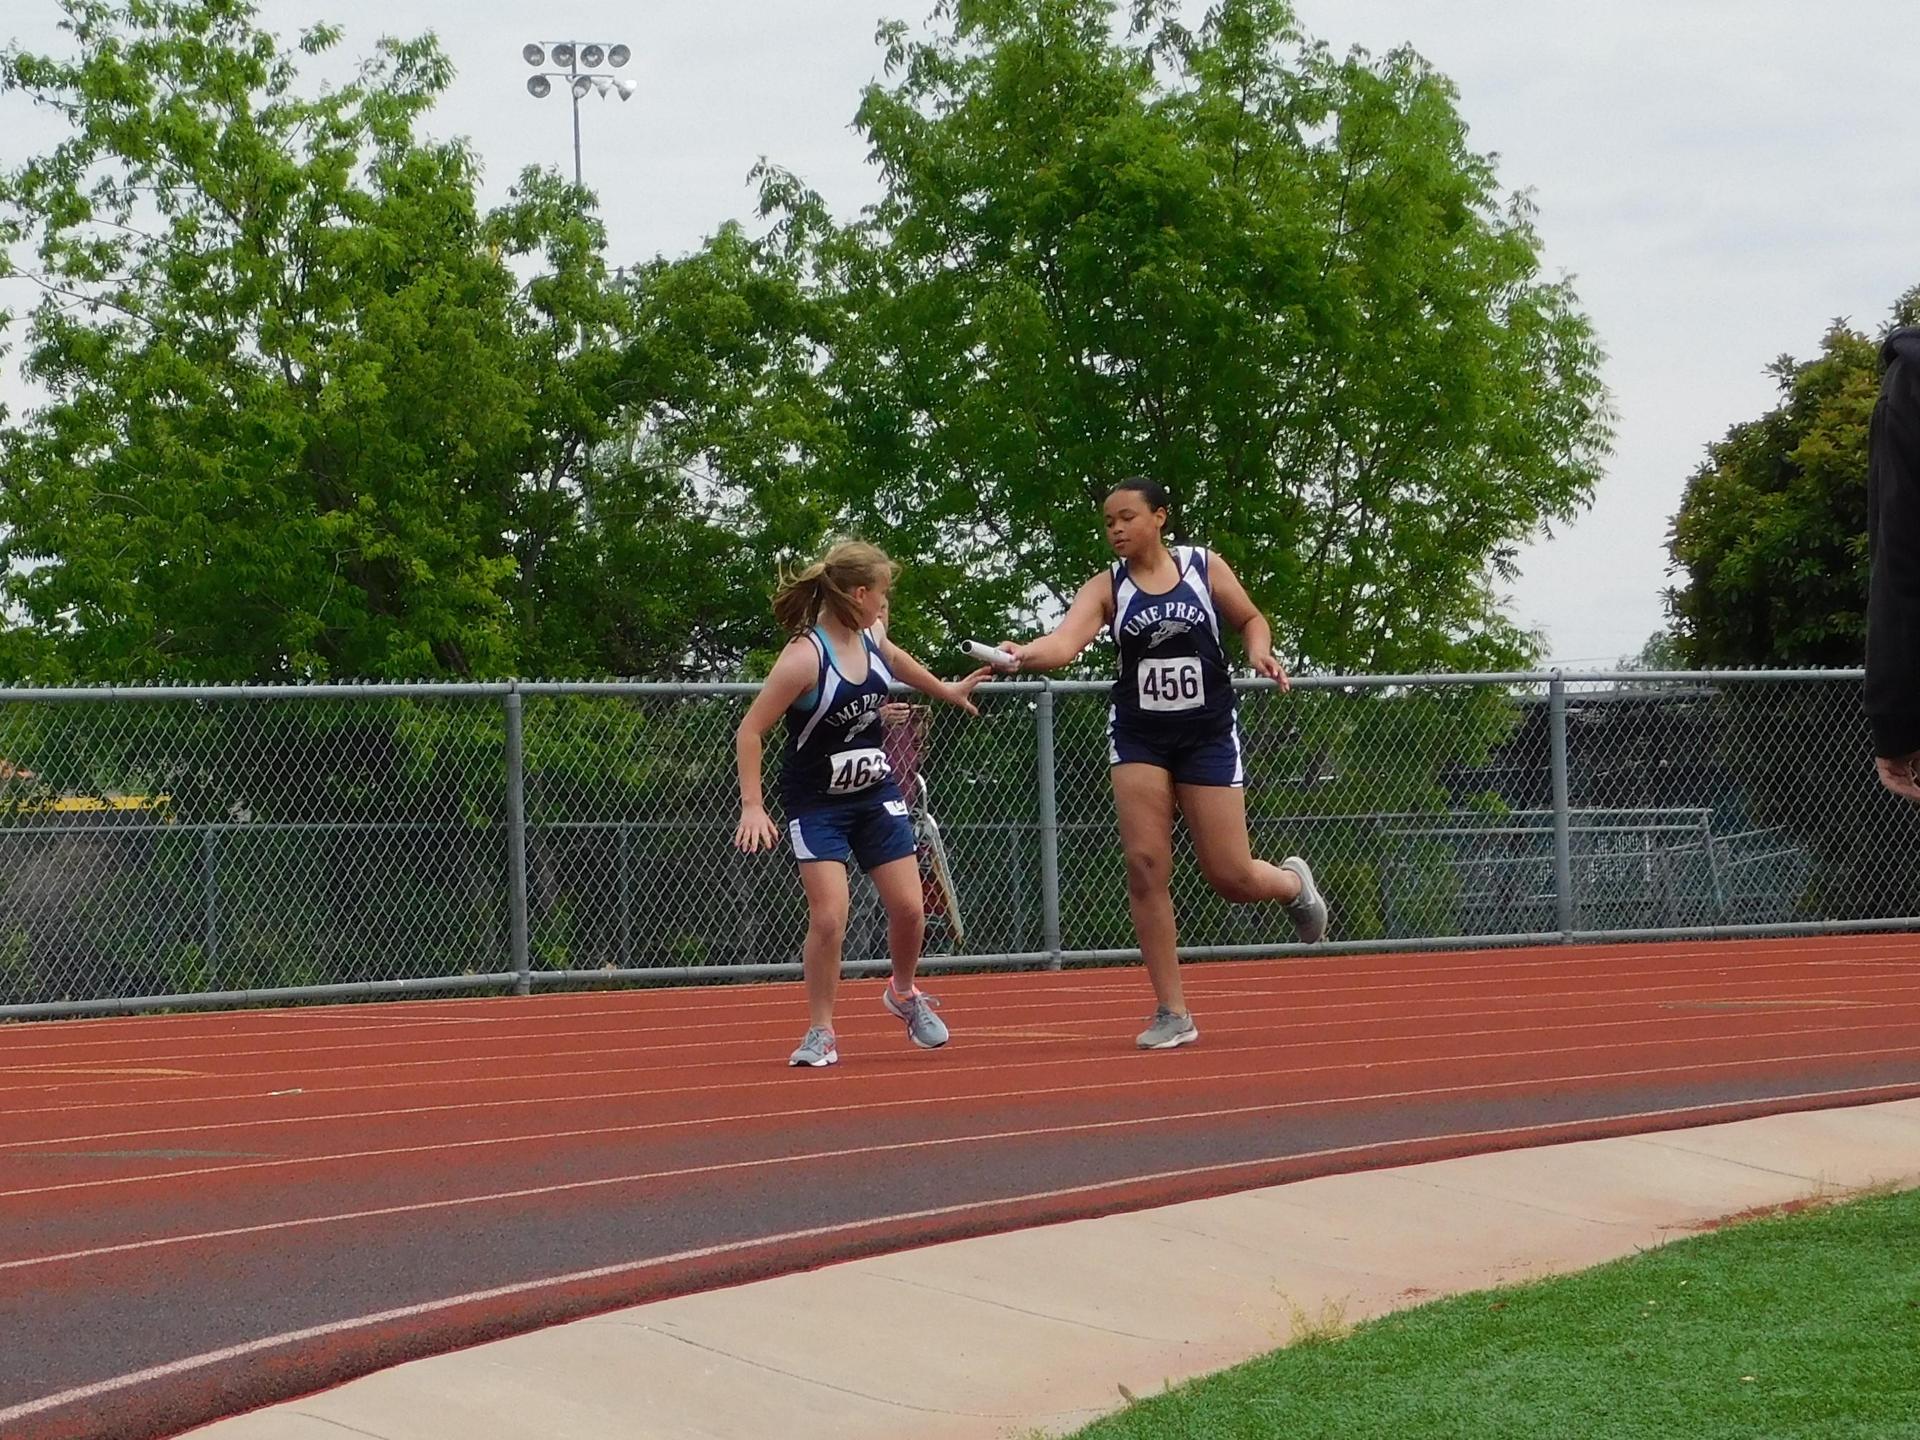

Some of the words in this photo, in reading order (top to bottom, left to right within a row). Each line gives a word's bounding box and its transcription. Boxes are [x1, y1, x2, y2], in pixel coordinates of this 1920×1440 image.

[1124, 605, 1162, 636] UME
[1165, 601, 1206, 626] PREP
[1143, 665, 1199, 702] 456
[825, 700, 859, 727] UME
